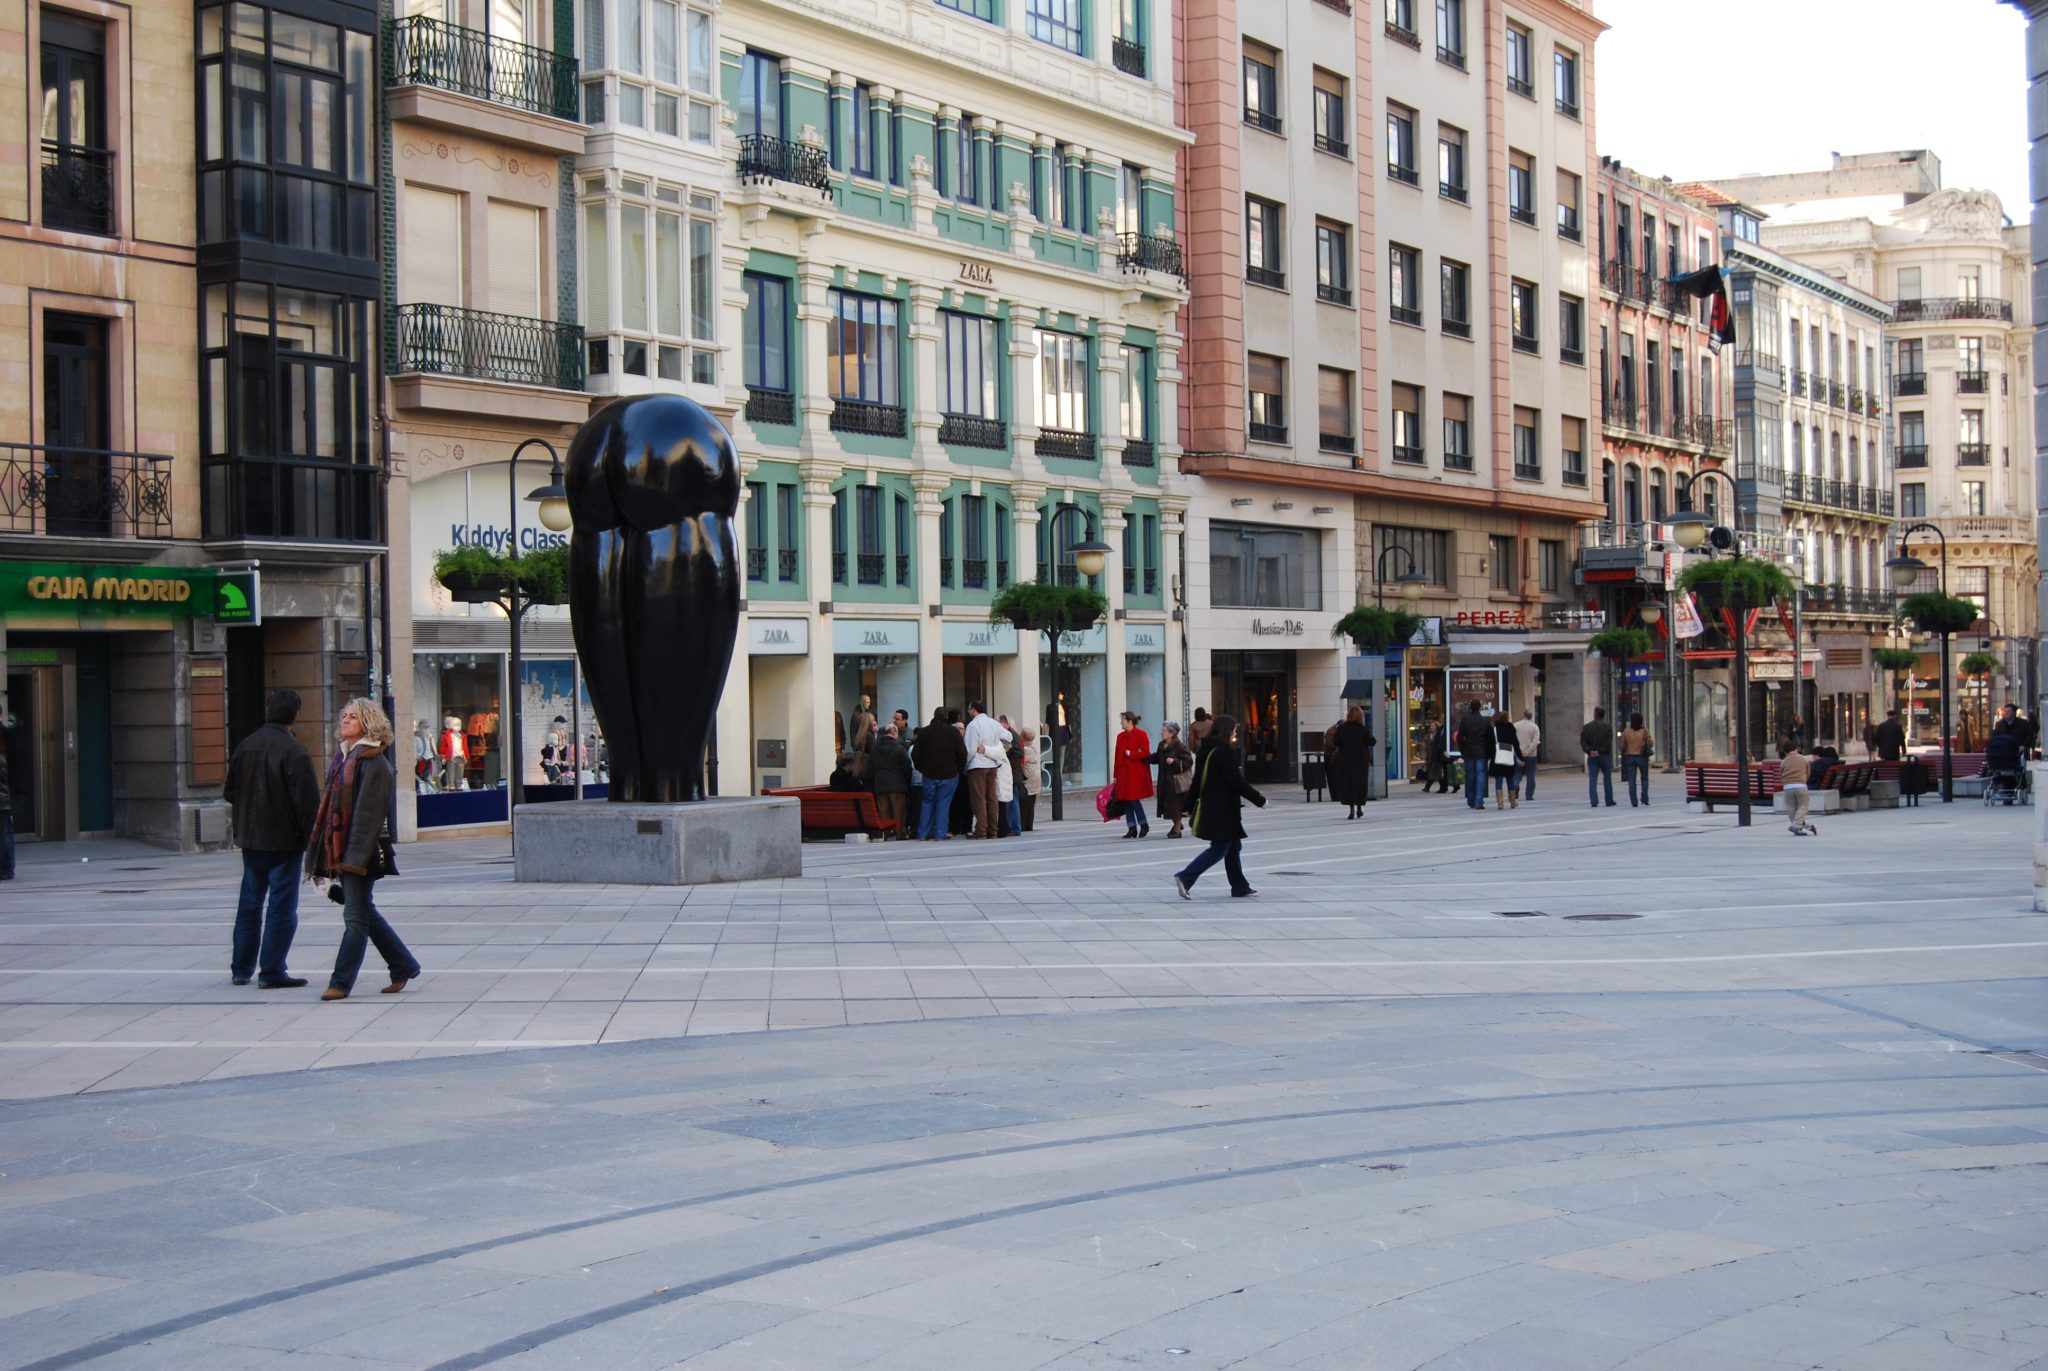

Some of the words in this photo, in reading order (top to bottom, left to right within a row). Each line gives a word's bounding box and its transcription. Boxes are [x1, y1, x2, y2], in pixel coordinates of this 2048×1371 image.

[960, 261, 993, 284] ZARA
[452, 524, 513, 554] Kiddy's
[520, 528, 567, 550] Class
[28, 576, 89, 600] CAJA
[92, 577, 191, 602] MADRID
[1457, 610, 1525, 625] PEREZ
[346, 627, 359, 642] 7
[763, 629, 790, 642] ZARA
[863, 631, 889, 644] ZARA
[968, 632, 991, 644] ZARA
[1134, 634, 1154, 645] ZARA
